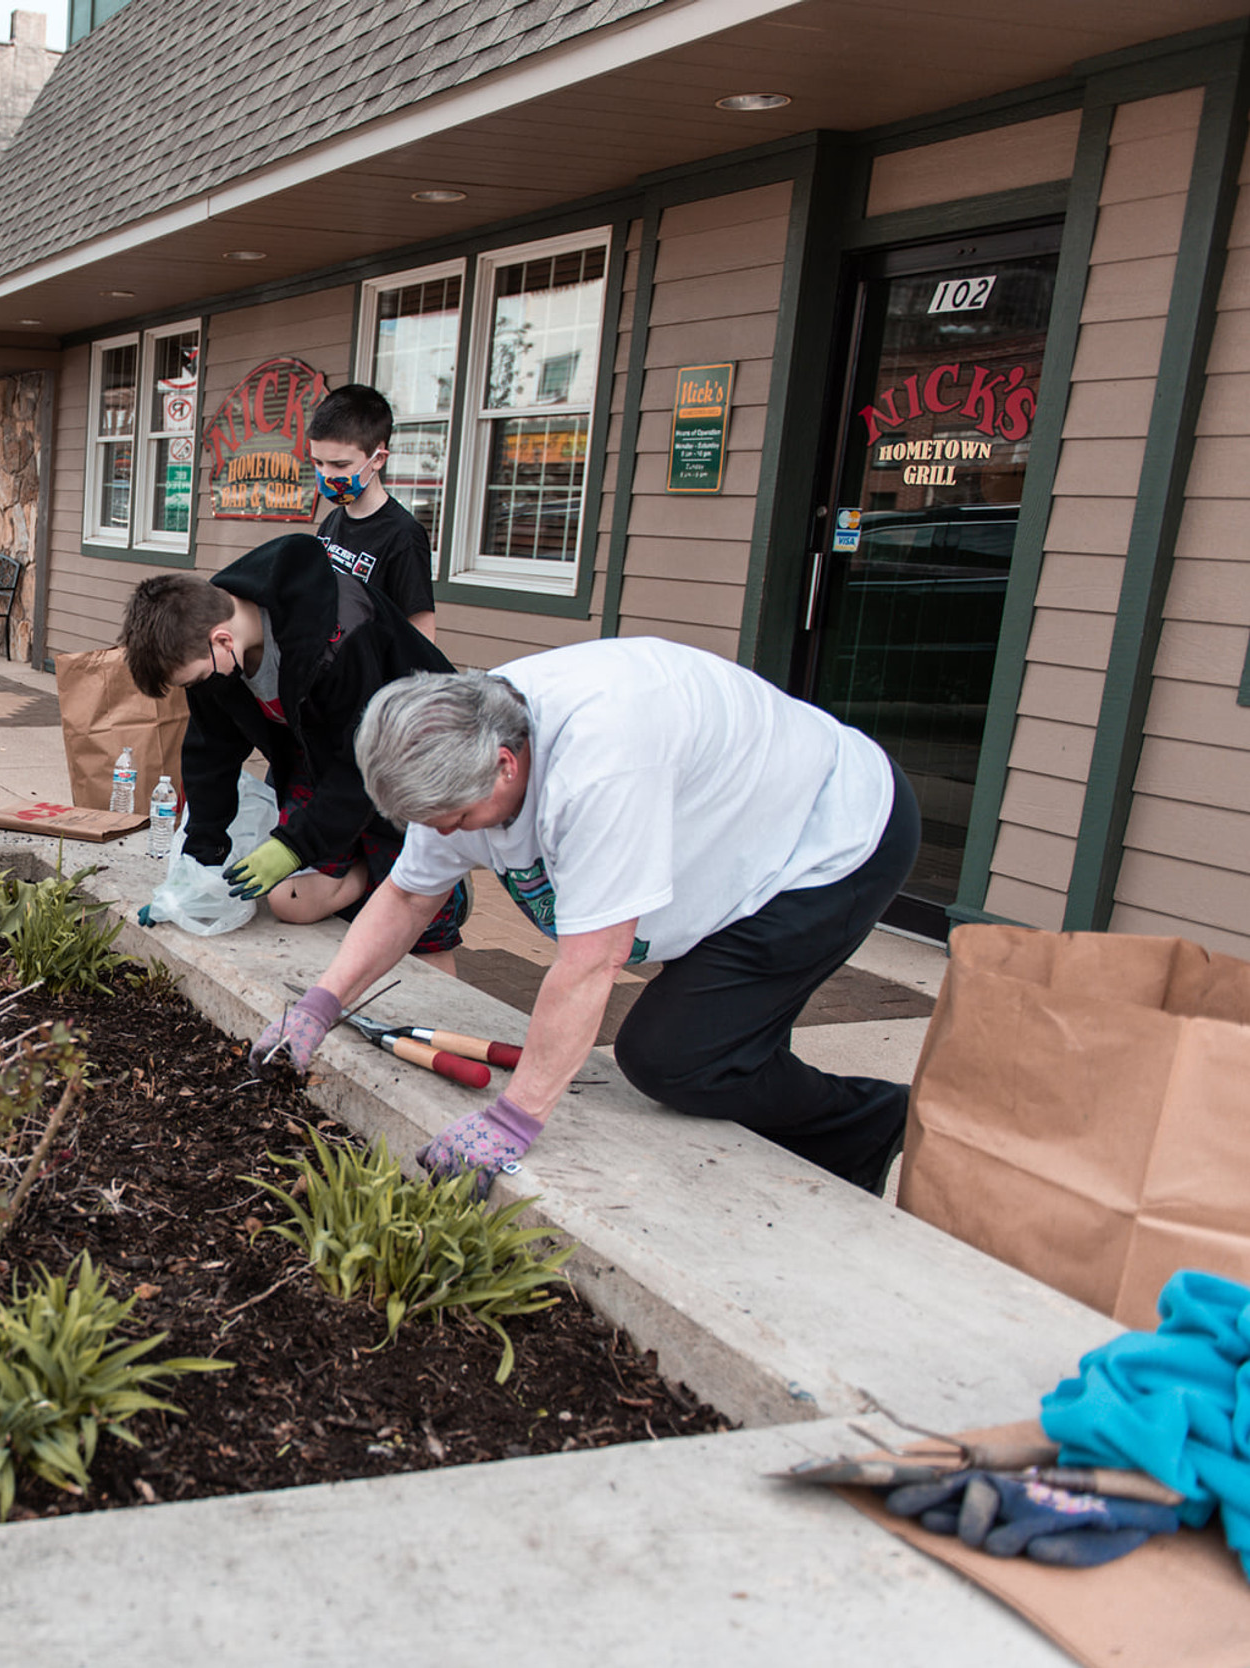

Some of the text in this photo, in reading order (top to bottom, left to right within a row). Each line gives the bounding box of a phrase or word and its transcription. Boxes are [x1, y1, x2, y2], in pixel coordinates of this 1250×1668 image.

[935, 279, 990, 310] 102
[857, 363, 1037, 446] NICK'S
[209, 370, 324, 479] NICK'
[878, 439, 992, 461] HOMETOWN
[228, 451, 299, 483] HOMETOWN
[903, 465, 956, 486] GRILL
[221, 482, 304, 509] BAR & GRILL
